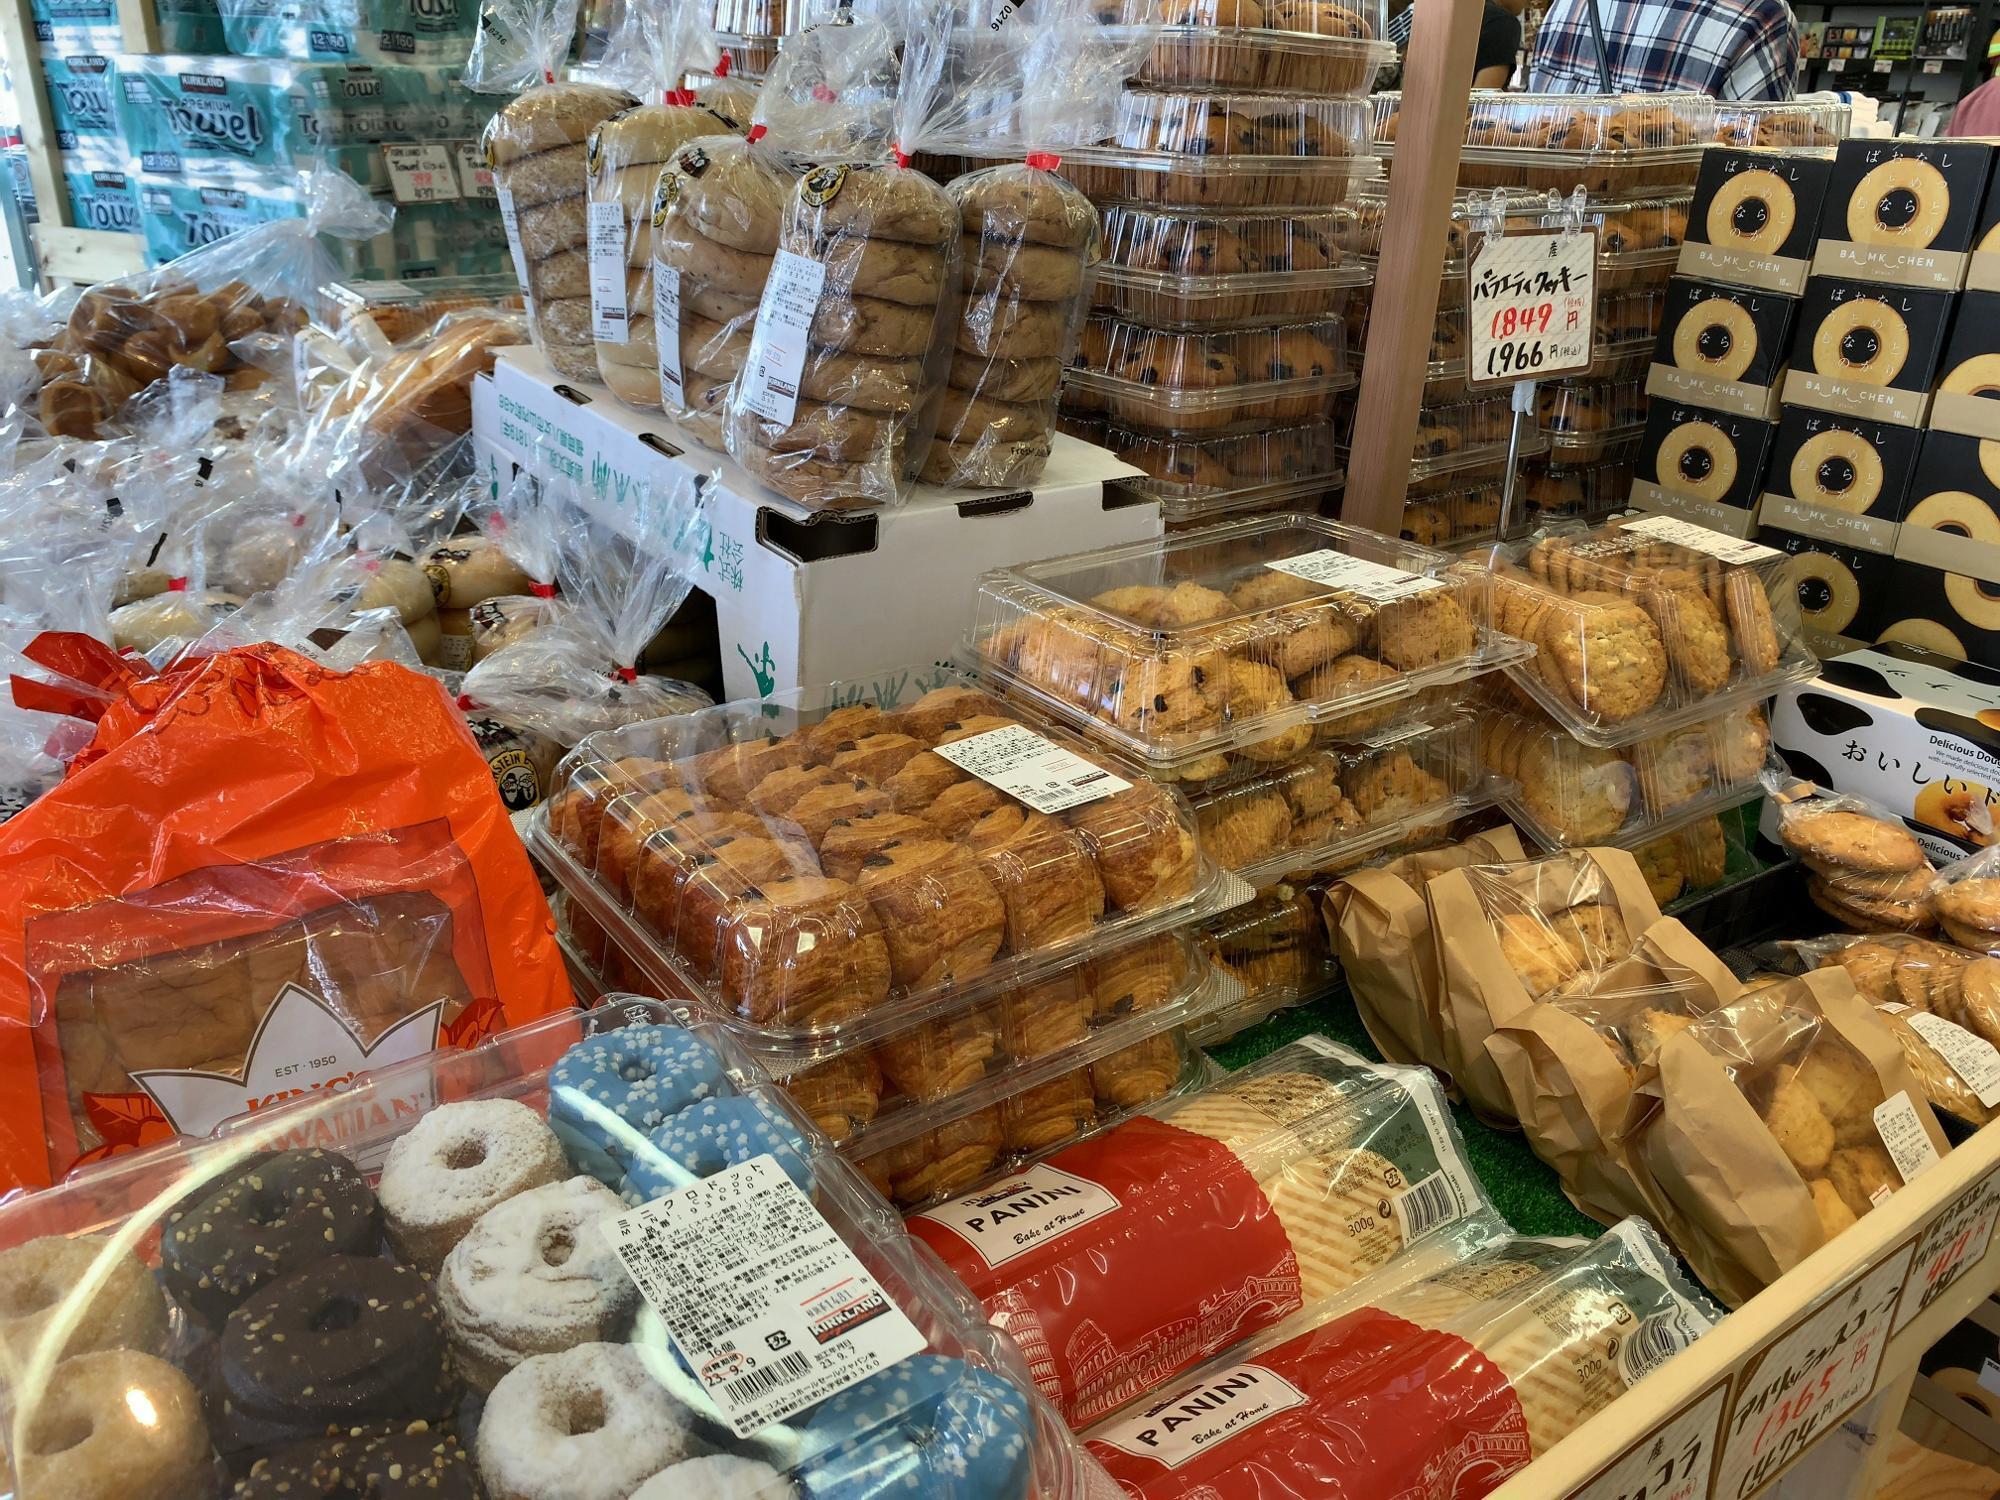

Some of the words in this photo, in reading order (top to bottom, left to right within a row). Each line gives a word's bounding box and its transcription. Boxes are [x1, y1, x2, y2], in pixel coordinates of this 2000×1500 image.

[990, 5, 1012, 32] 0216
[488, 28, 507, 46] 0216
[181, 75, 224, 88] KIRKLAND
[161, 100, 262, 144] Towel
[1929, 735, 1974, 757] Delicious
[1941, 759, 1966, 774] carefully
[1967, 768, 1991, 781] selected
[1963, 757, 1989, 772] delicious
[1917, 837, 1961, 861] Delicious
[275, 1064, 299, 1078] EST
[309, 1055, 337, 1070] 1950
[613, 1161, 765, 1229] ミニクロドット
[618, 1210, 672, 1236] MINI
[689, 1169, 768, 1206] CRODOT
[1457, 1195, 1468, 1214] Batch
[965, 1185, 1081, 1233] PANINI
[1013, 1229, 1041, 1245] Bake
[1044, 1221, 1055, 1232] at
[1054, 1207, 1086, 1225] Home
[1348, 1214, 1375, 1238] 300g
[808, 1293, 885, 1336] KIRKLAND
[706, 1339, 737, 1360] 16個
[1577, 1358, 1602, 1384] 300g
[1136, 1372, 1260, 1447] PANINI
[1191, 1427, 1222, 1445] Bake
[1225, 1418, 1236, 1430] at
[1236, 1402, 1269, 1421] Home
